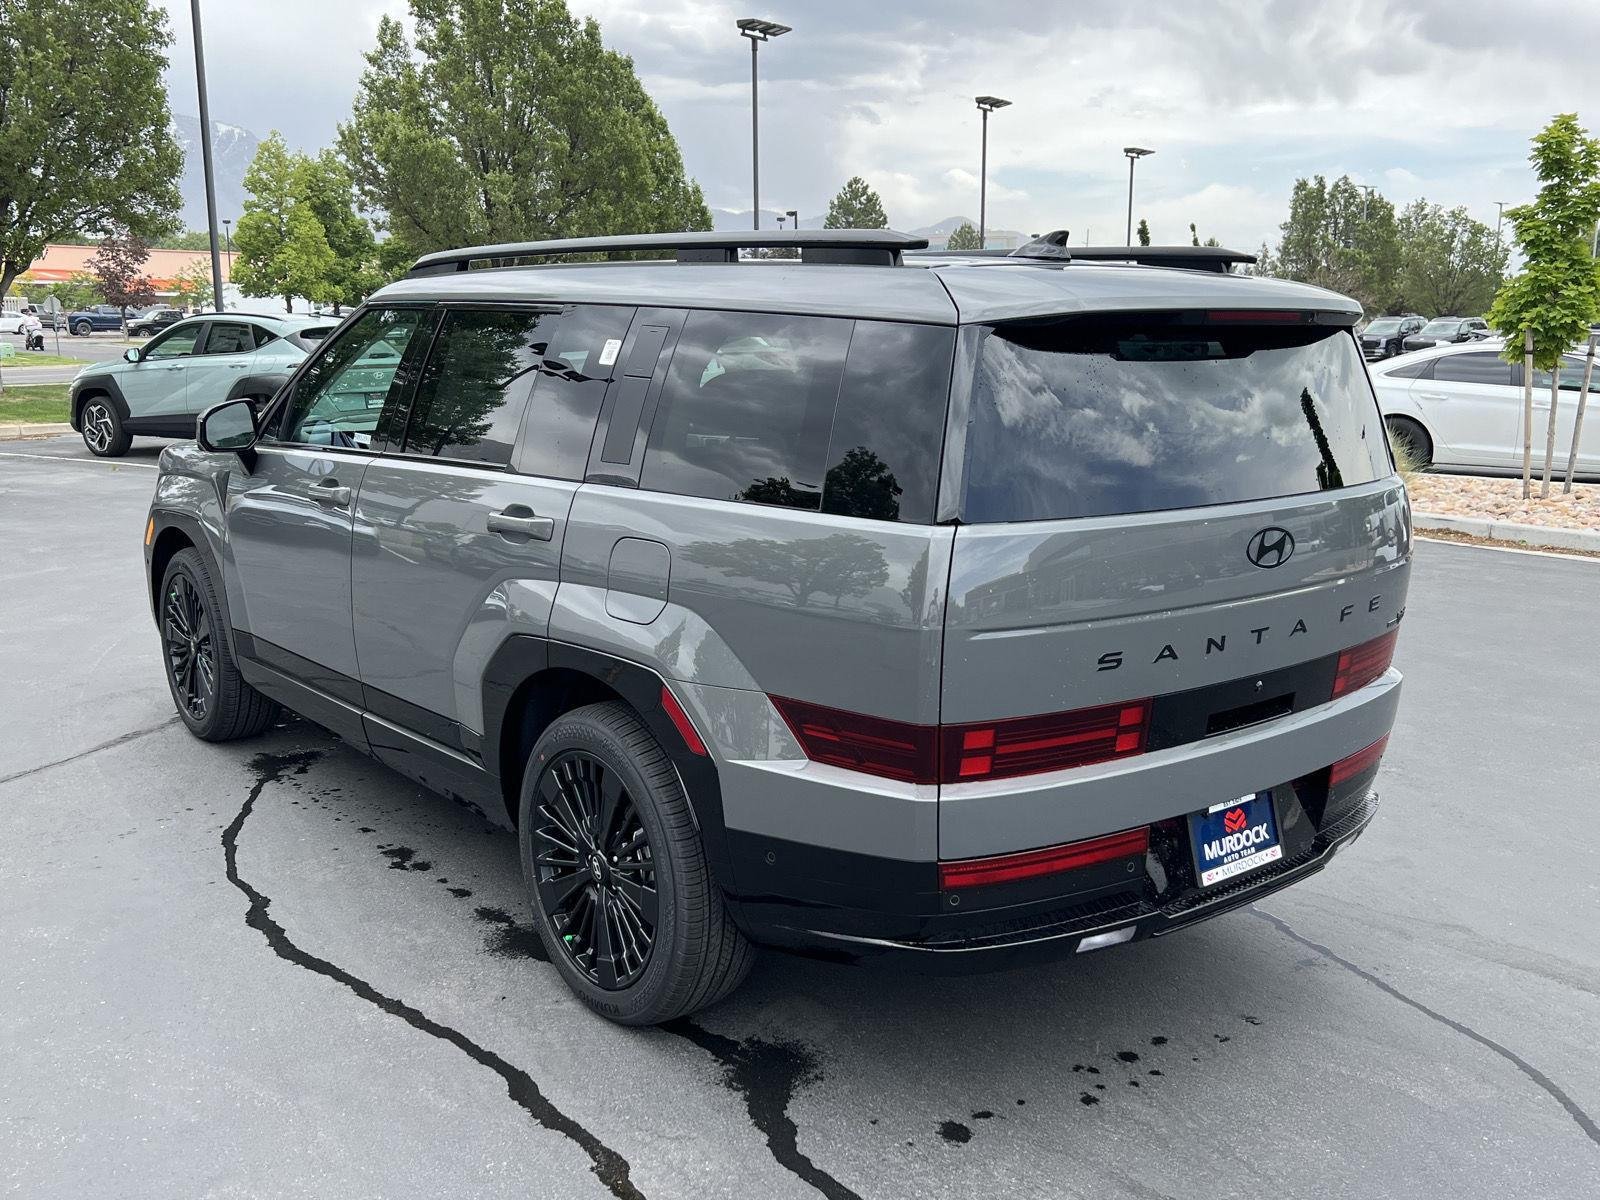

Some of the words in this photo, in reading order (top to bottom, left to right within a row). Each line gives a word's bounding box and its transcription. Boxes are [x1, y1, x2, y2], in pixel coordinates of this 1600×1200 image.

[1097, 618, 1308, 672] SANTA
[1340, 594, 1381, 622] FE
[1203, 822, 1270, 861] MURDOCK
[1223, 852, 1240, 864] AUTO
[1240, 846, 1256, 858] TEAM
[1221, 854, 1266, 876] MURDOCK
